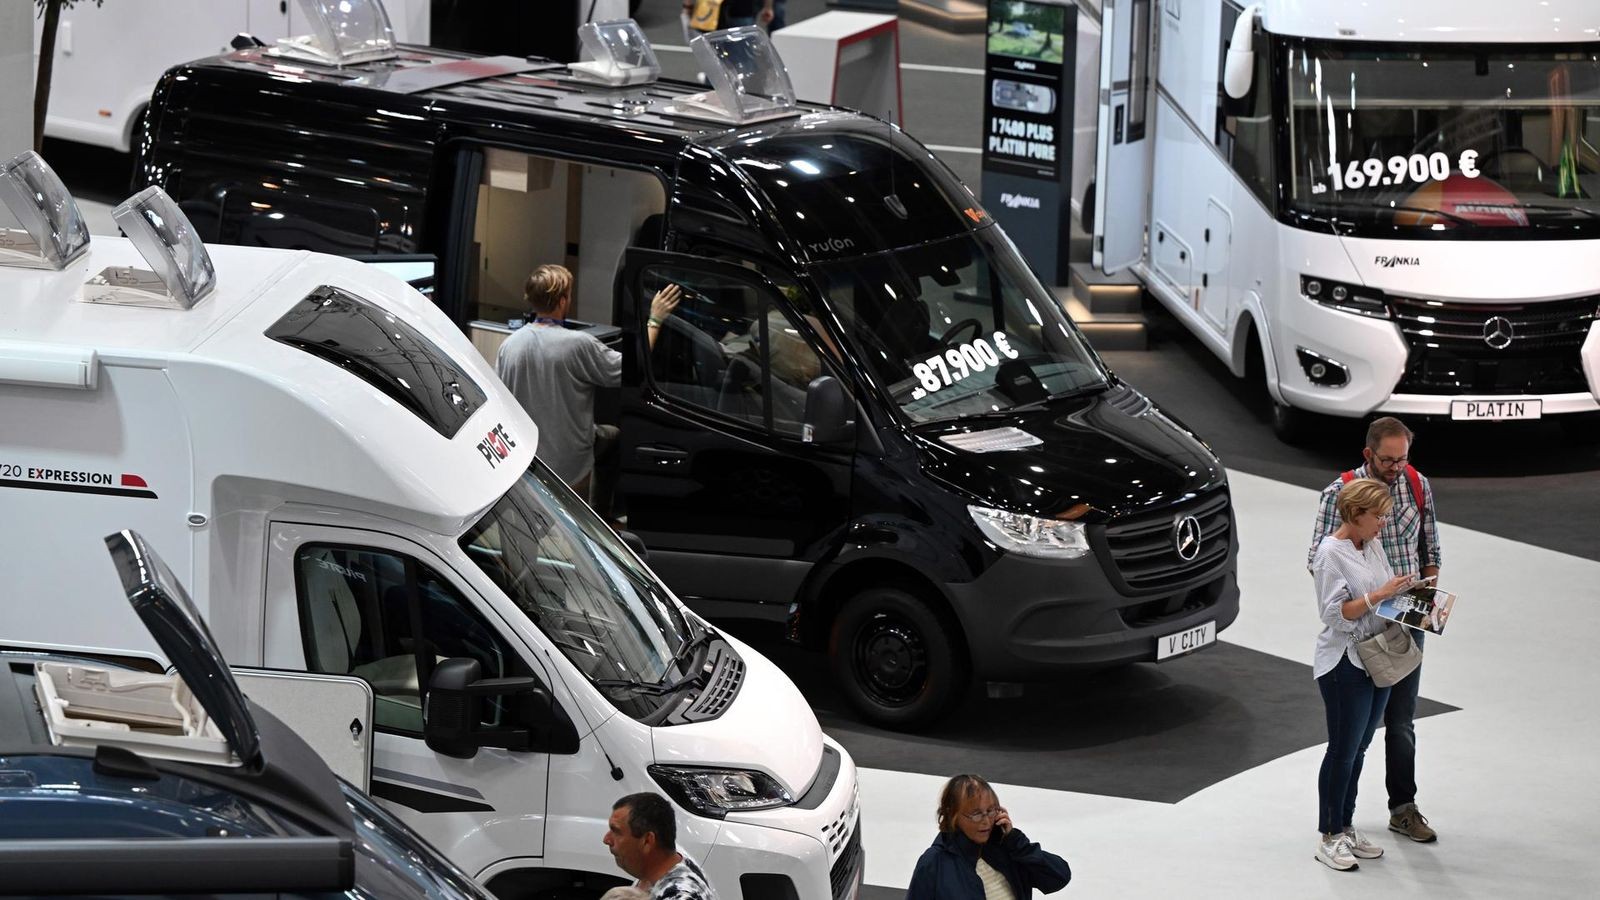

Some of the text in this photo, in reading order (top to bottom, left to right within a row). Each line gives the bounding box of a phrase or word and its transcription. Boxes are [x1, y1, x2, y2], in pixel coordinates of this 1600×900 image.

[1026, 122, 1054, 142] PLUS
[989, 135, 1056, 162] PLATIN PURE
[1312, 149, 1480, 194] ab 169.900 €
[912, 338, 1000, 392] 87.900
[993, 331, 1019, 359] €
[1467, 402, 1524, 417] PLATIN
[28, 467, 112, 485] EXPRESSION
[1169, 626, 1207, 653] V CITY
